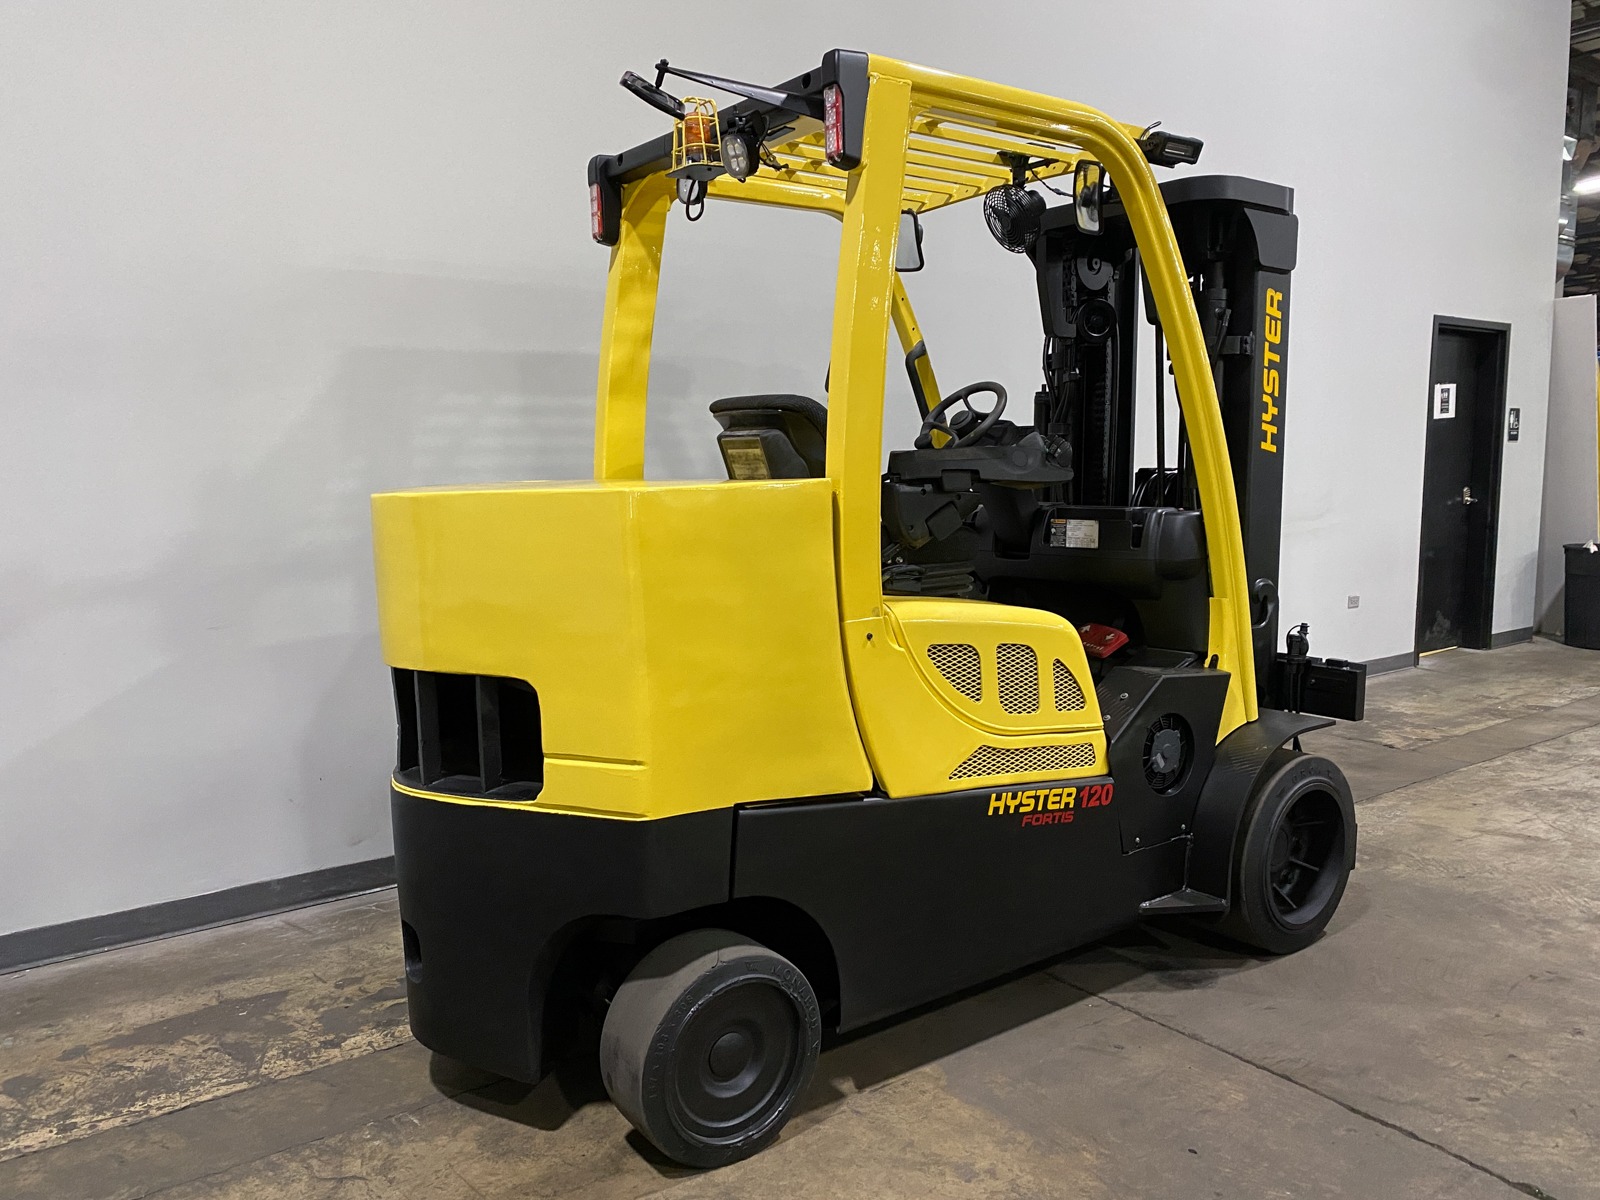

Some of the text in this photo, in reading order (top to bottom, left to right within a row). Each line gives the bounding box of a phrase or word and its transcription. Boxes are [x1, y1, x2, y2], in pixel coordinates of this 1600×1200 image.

[1260, 287, 1283, 453] HYSTER
[987, 783, 1114, 816] HYSTER 120
[1021, 811, 1074, 827] FORTIS
